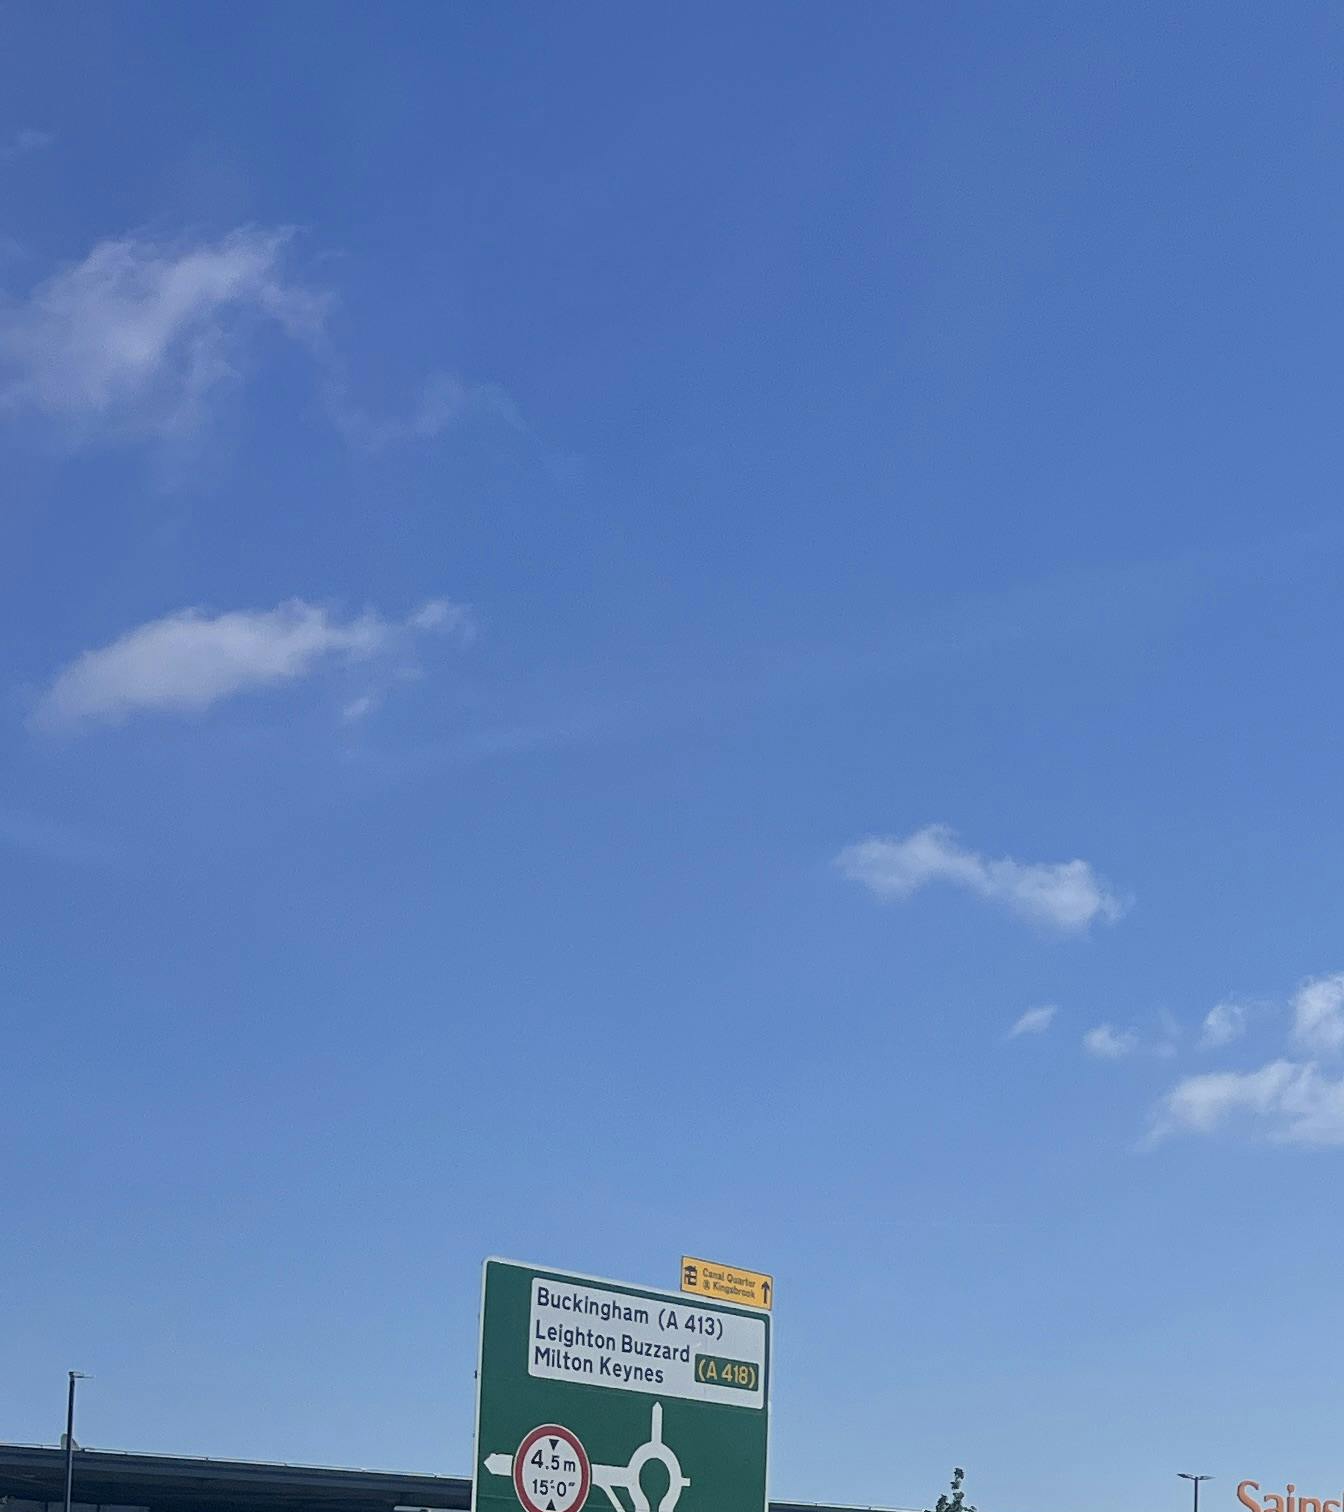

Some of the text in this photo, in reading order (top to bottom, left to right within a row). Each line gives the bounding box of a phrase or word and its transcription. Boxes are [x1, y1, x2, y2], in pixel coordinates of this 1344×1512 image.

[537, 1286, 649, 1325] Buckingham
[536, 1319, 690, 1363] Leighton Buzzard
[534, 1346, 664, 1384] Milton Keynes
